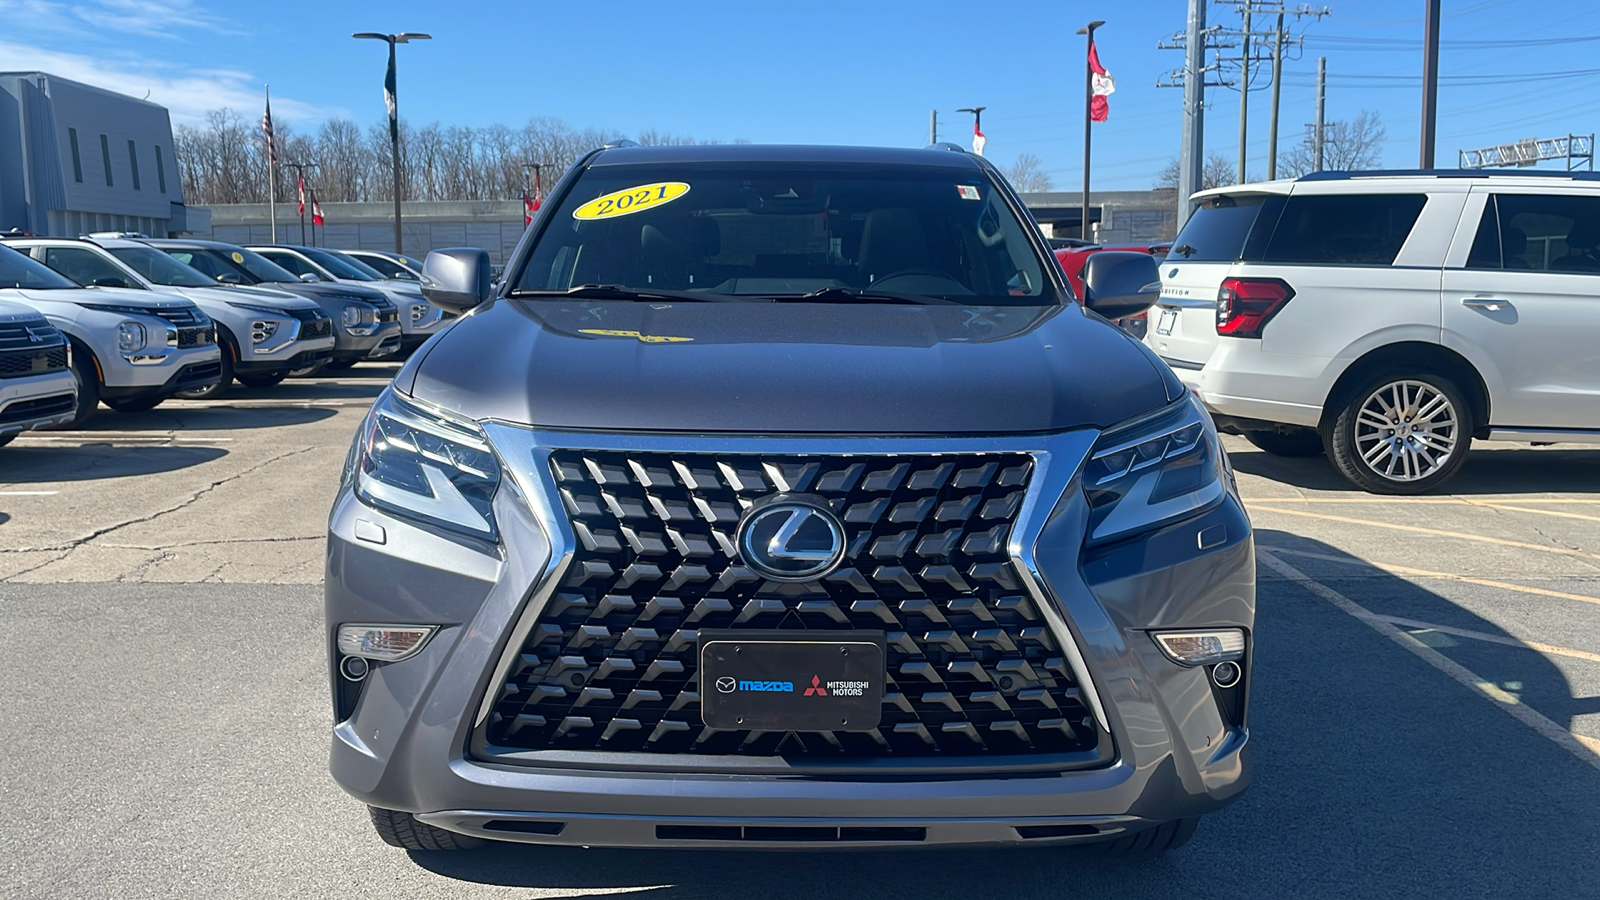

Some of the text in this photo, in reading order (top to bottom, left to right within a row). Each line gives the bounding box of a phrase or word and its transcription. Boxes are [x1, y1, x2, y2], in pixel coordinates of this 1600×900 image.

[597, 186, 667, 215] 2021
[827, 681, 869, 689] MITSUBISHI
[833, 688, 863, 696] MOTORS
